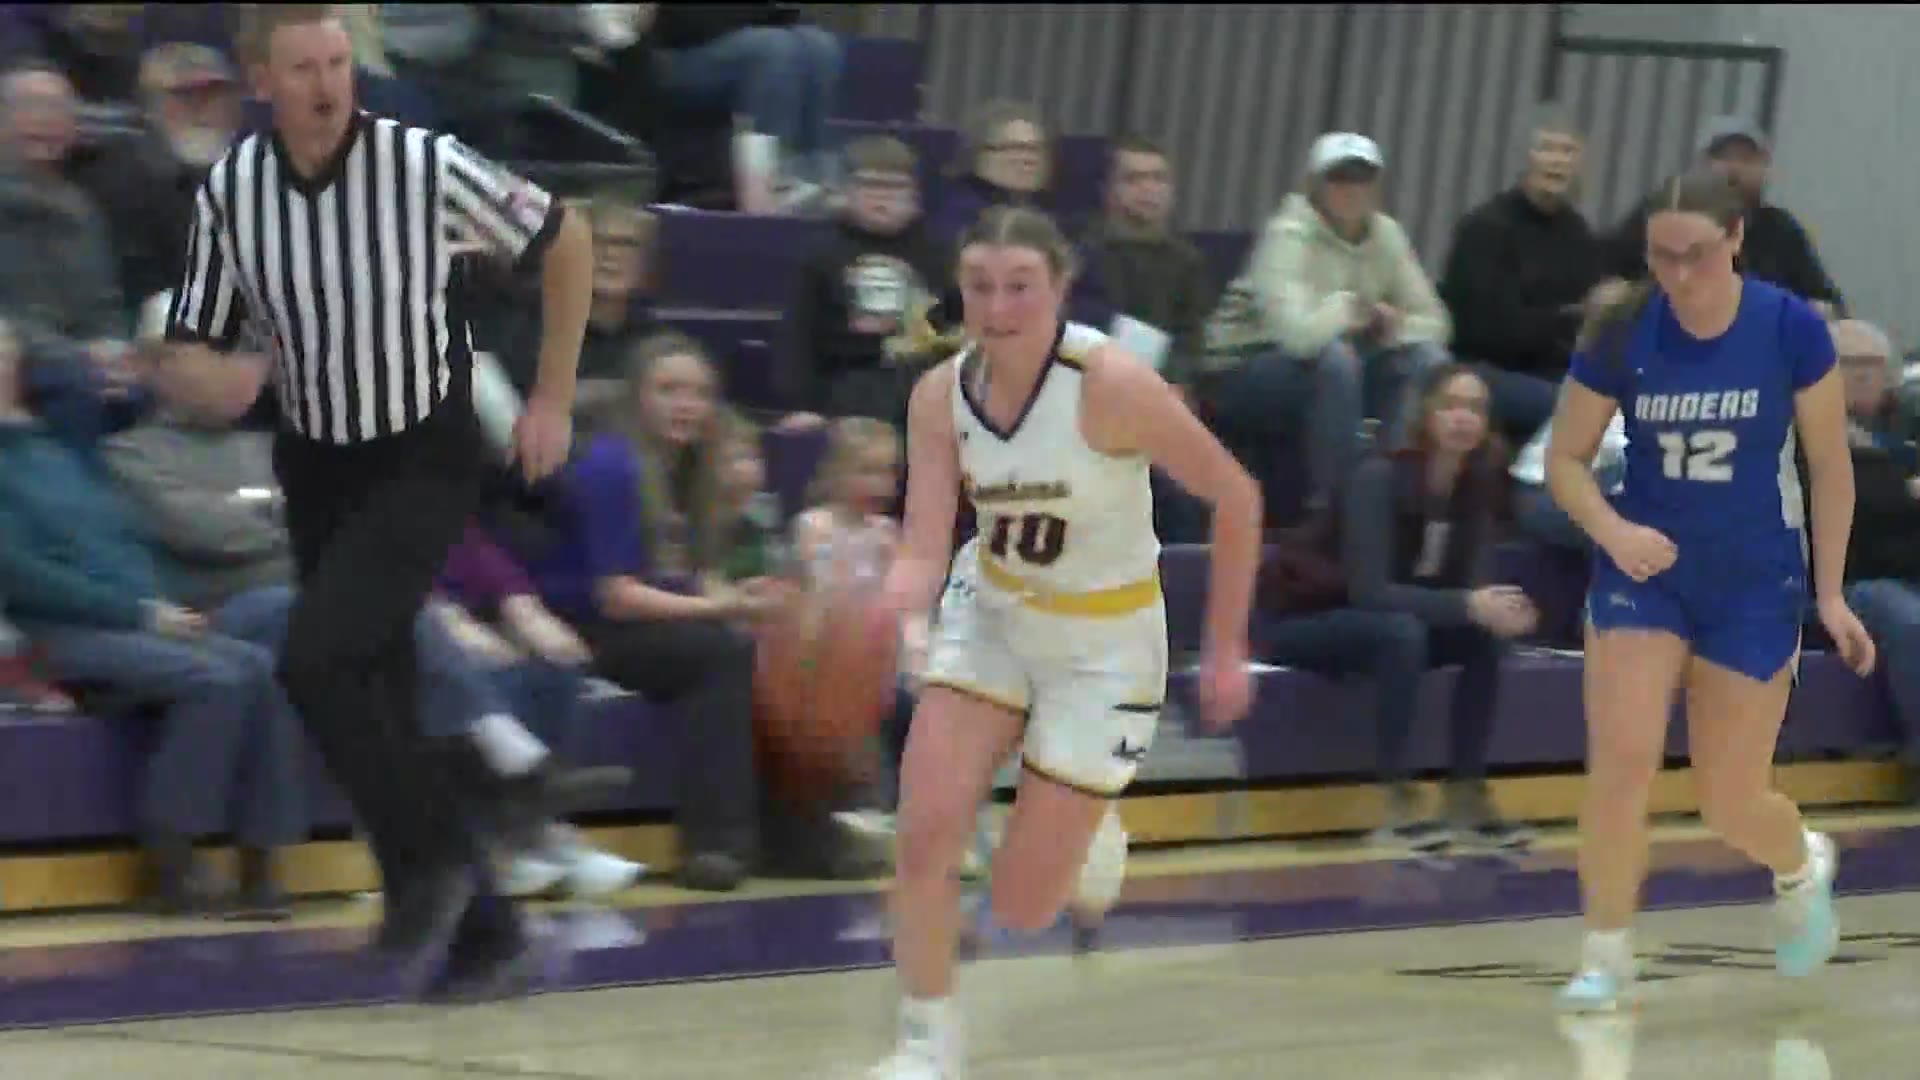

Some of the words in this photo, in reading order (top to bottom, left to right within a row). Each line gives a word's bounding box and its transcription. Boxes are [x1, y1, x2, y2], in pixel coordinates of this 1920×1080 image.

[1635, 389, 1759, 421] RAIDERS
[1657, 430, 1737, 482] 12
[990, 513, 1067, 566] 10
